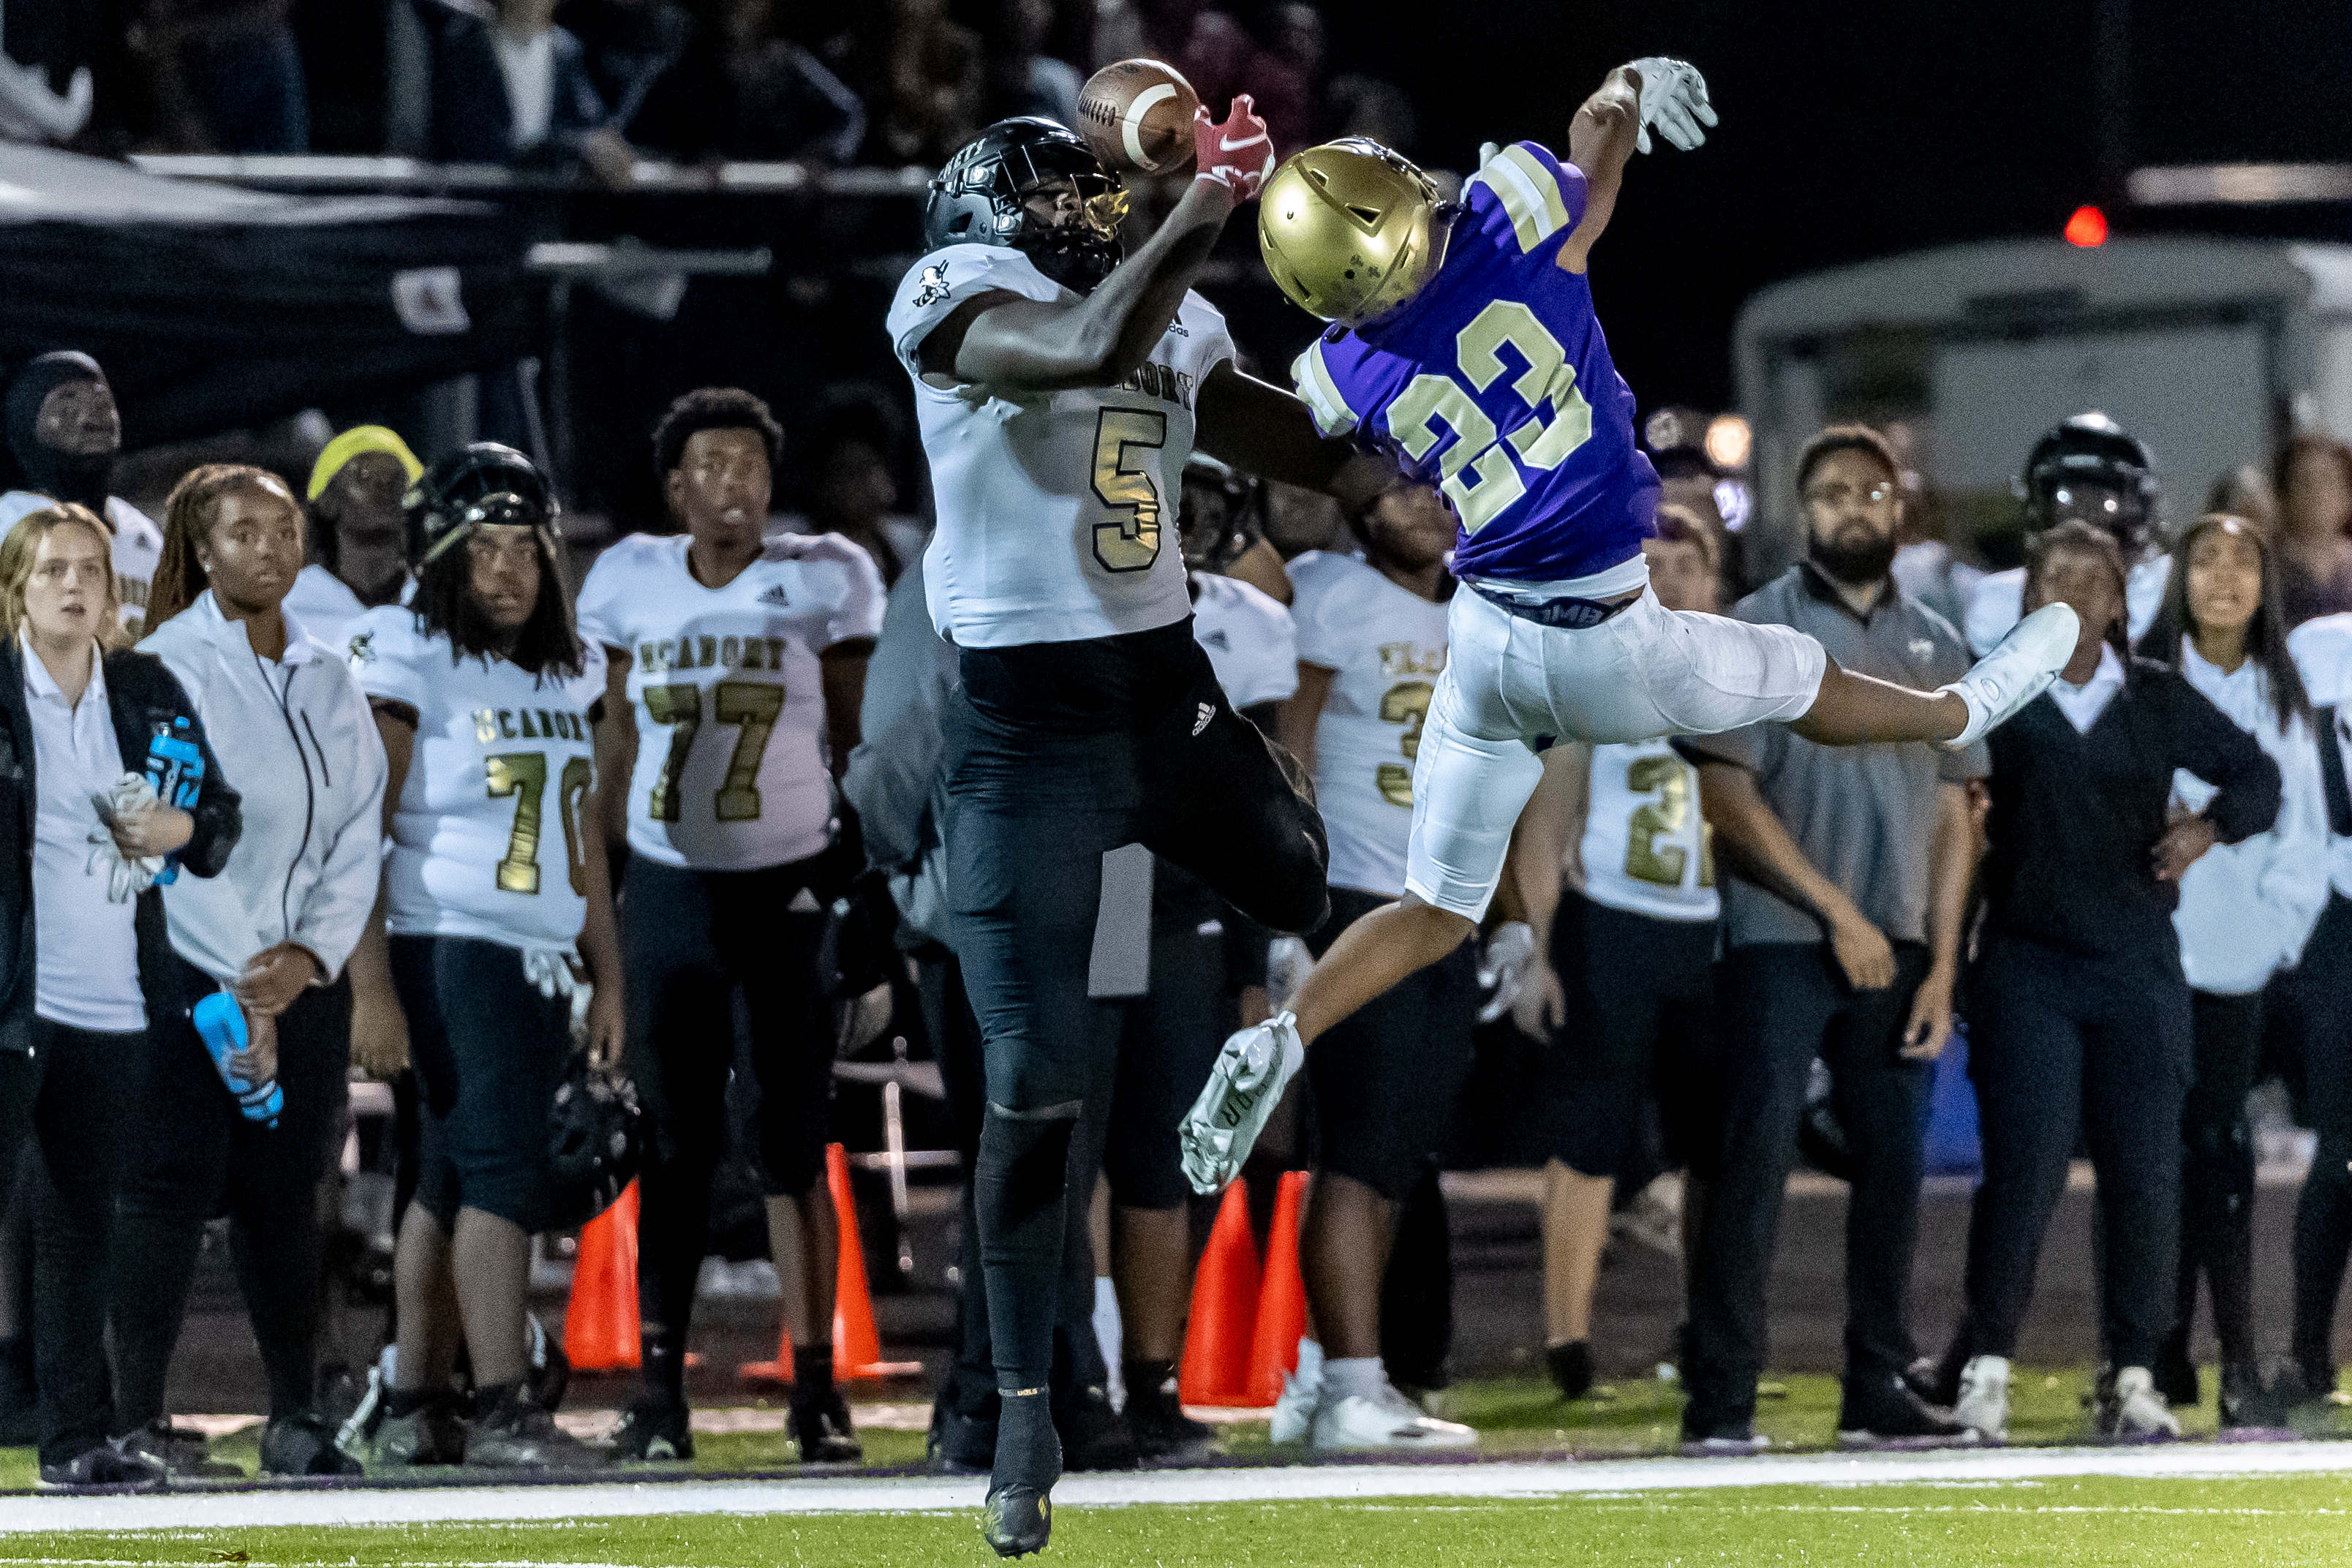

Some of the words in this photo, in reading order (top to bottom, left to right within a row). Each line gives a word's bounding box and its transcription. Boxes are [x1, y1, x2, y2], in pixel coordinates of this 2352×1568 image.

[1090, 406, 1167, 573] 5
[1386, 298, 1593, 536] 23
[642, 682, 785, 822] 77
